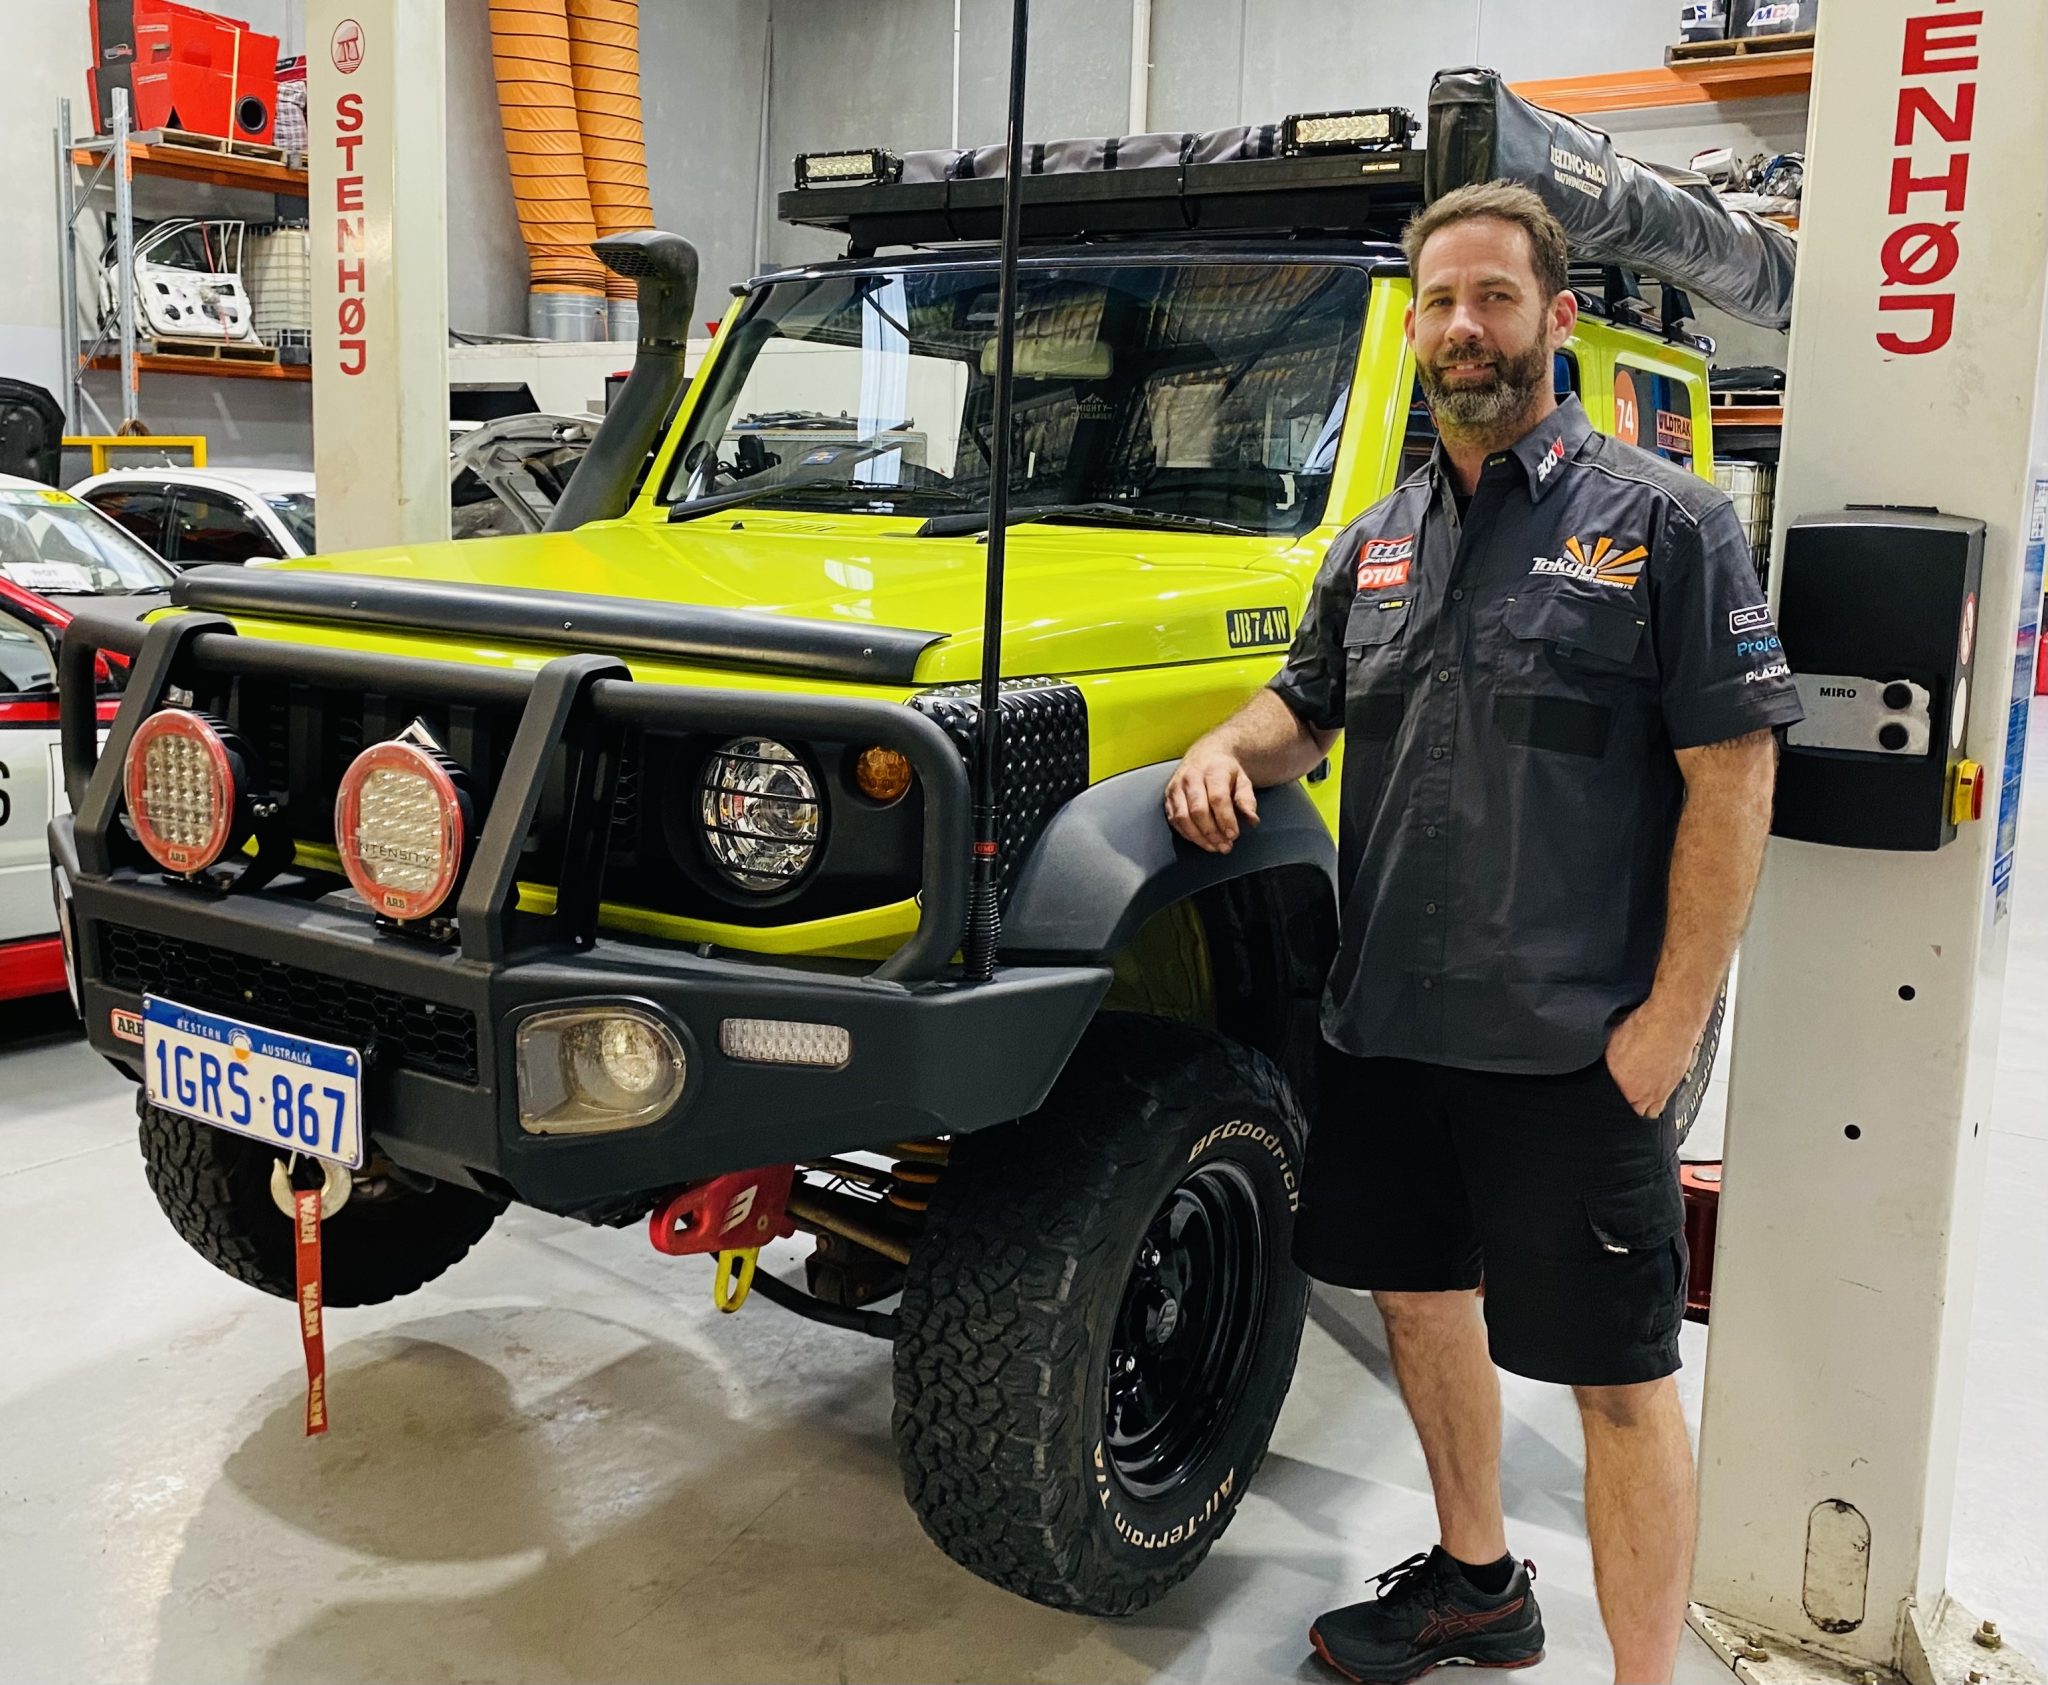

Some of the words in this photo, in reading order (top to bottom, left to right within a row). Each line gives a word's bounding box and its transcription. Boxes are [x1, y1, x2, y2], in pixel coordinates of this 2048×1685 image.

[1876, 0, 1983, 354] ENHØJ
[336, 94, 366, 375] STENHØJ
[1617, 398, 1634, 434] 74
[1537, 435, 1565, 482] 300V
[1357, 564, 1404, 586] OTUL
[1529, 556, 1598, 578] Tokyo
[1230, 609, 1287, 644] JB74W
[1819, 687, 1857, 699] MIRO
[385, 896, 406, 909] ARB
[176, 1018, 221, 1041] WESTERN
[261, 1043, 312, 1066] AUSTRALIA
[1187, 1120, 1299, 1212] BFGoodrich
[300, 1195, 317, 1244] WARN
[303, 1281, 320, 1338] WARN
[309, 1372, 323, 1427] WARN
[1094, 1440, 1111, 1510] T/A
[1114, 1467, 1234, 1549] All-Terrain
